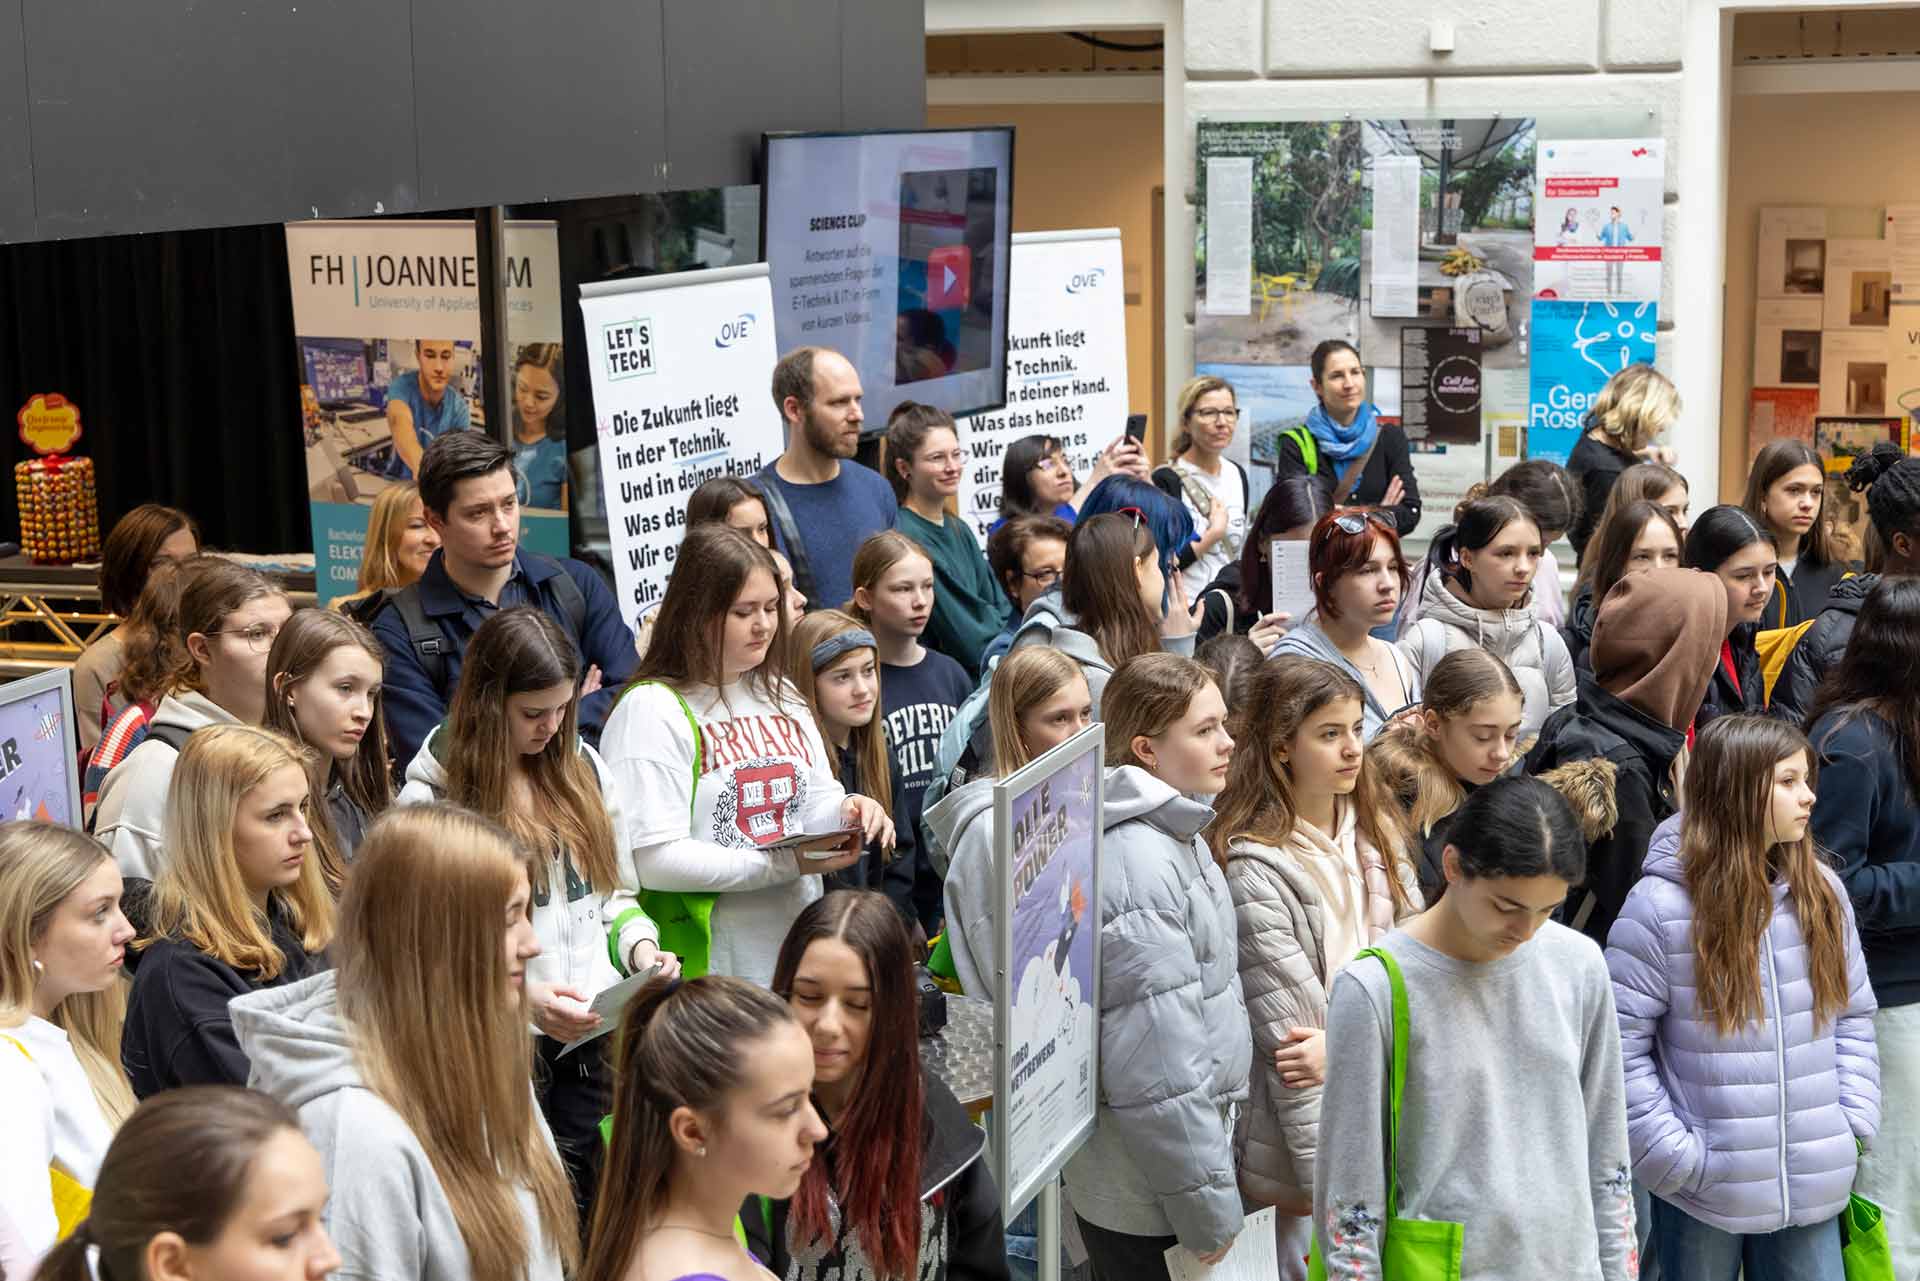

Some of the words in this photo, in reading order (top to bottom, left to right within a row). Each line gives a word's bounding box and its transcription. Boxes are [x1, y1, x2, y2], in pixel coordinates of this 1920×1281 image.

[809, 216, 847, 231] SCIENCE
[310, 255, 344, 285] FH
[366, 255, 533, 288] JOANNEM
[1072, 273, 1097, 289] OVE
[721, 321, 748, 341] OVE
[1008, 331, 1052, 352] kunft
[1055, 329, 1086, 348] liegt
[609, 348, 652, 374] TECH
[1014, 355, 1078, 377] Technik.
[1019, 383, 1070, 402] deiner
[1072, 377, 1110, 396] Hand.
[1549, 384, 1597, 410] Ger
[612, 409, 639, 437] Die
[641, 399, 703, 431] Zukunft
[705, 394, 739, 418] liegt
[969, 415, 1005, 433] Was
[1009, 412, 1032, 428] das
[1036, 404, 1084, 425] heißt?
[616, 446, 633, 470] in
[635, 444, 666, 467] der
[669, 427, 731, 459] Technik.
[971, 441, 1003, 459] Wir
[1073, 433, 1088, 446] es
[620, 476, 654, 504] Und
[655, 472, 675, 496] in
[725, 453, 763, 477] Hand
[624, 513, 661, 537] Was
[664, 506, 687, 529] da
[328, 544, 364, 560] ELEKT
[628, 543, 660, 571] Wir
[330, 565, 358, 581] COM
[634, 578, 663, 605] dir.
[898, 738, 940, 777] HIL
